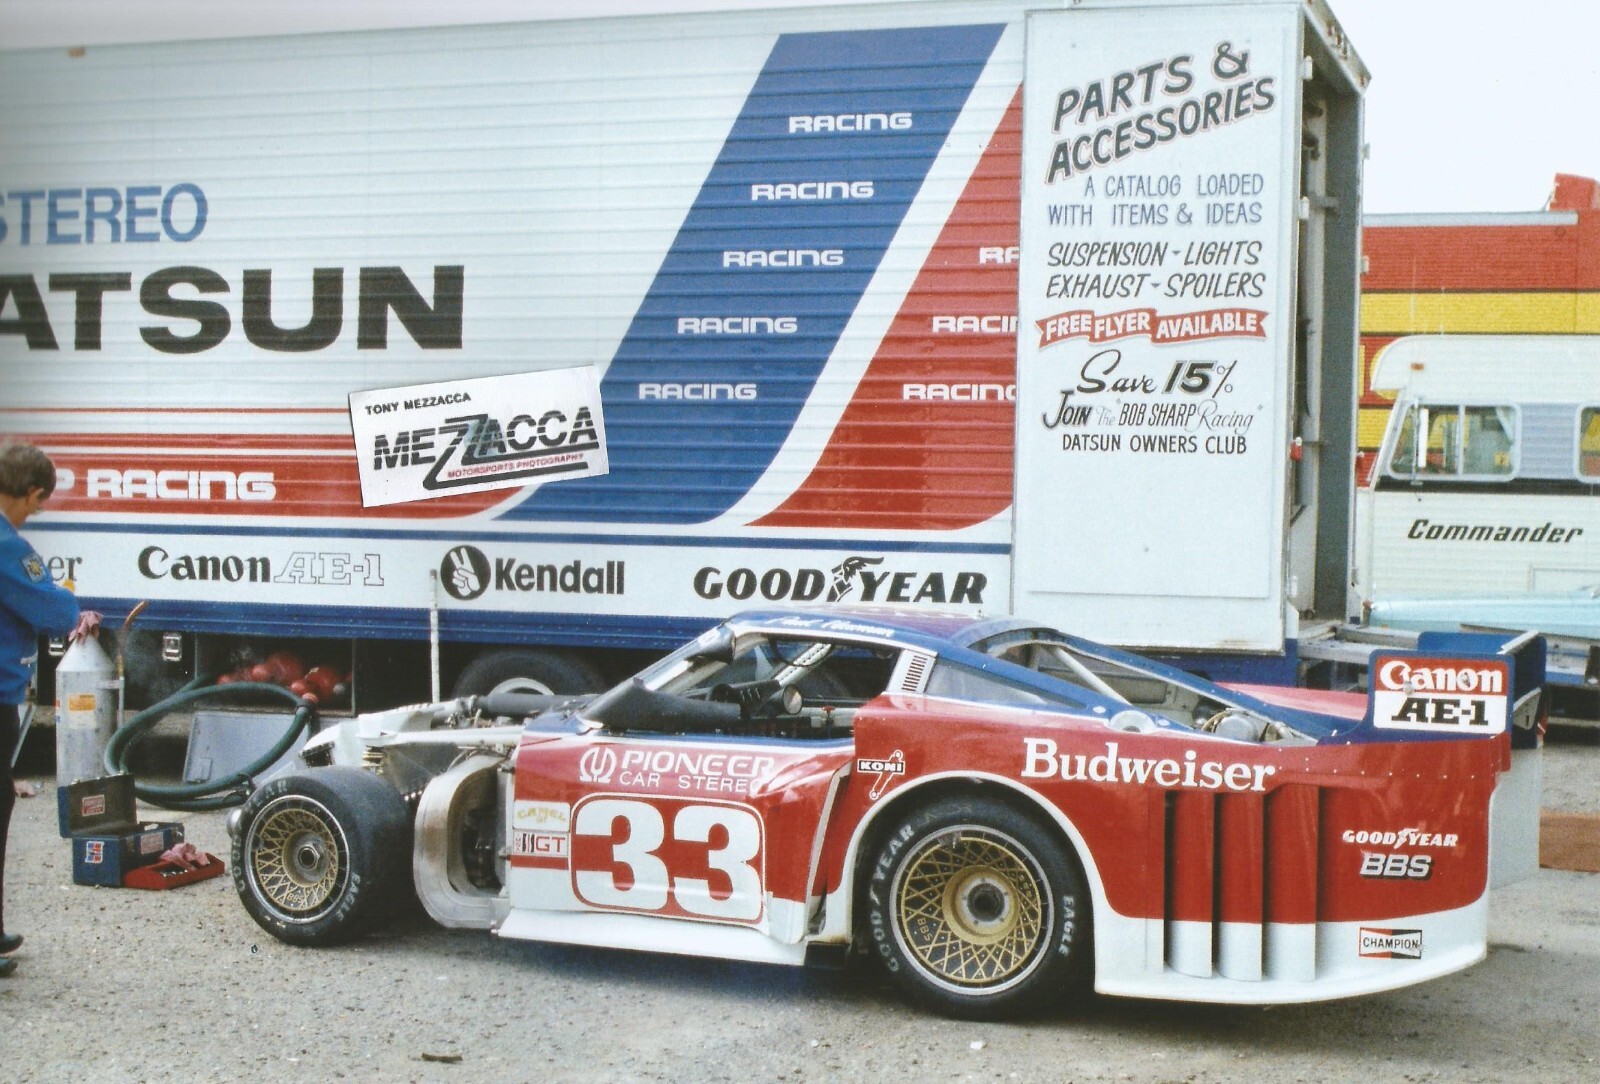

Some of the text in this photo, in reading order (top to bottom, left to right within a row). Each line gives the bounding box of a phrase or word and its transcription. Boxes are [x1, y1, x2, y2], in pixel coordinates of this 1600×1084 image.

[1053, 40, 1250, 132] PARTS &
[789, 112, 912, 132] RACING
[1046, 78, 1275, 183] ACCESSORIES
[751, 182, 874, 200] RACING
[1085, 173, 1264, 196] A CATALOG LOADED
[0, 182, 208, 244] TEREO
[1048, 202, 1263, 226] WITH ITEMS & IDEAS
[723, 249, 843, 267] RACING
[1047, 241, 1263, 267] SUSPENSION LIGHTS
[1046, 272, 1266, 299] EXHAUST SPOILERS
[678, 317, 797, 334] RACING
[933, 315, 1018, 333] RACI
[1046, 312, 1257, 340] FREE FLYER AVAILABLE
[1077, 349, 1238, 398] Save 15%
[638, 383, 757, 400] RACING
[1147, 402, 1197, 427] SHARP
[1062, 434, 1247, 454] DATSUN OWNERS CLUB
[87, 469, 276, 500] RACING
[1407, 519, 1583, 543] Commander
[138, 545, 384, 586] Canon AE-1
[495, 557, 625, 595] Kendall
[1380, 660, 1502, 692] Canon
[1391, 697, 1488, 725] AE-1
[621, 750, 774, 777] PIONEER
[860, 761, 903, 772] KONI
[1022, 738, 1275, 793] Budweiser
[619, 771, 661, 787] CAR
[535, 835, 566, 852] GT
[873, 824, 915, 881] YEAR
[575, 800, 760, 920] 33
[1360, 850, 1433, 880] BBS
[1058, 895, 1076, 956] EAGLE
[1363, 936, 1420, 949] CHAMPION
